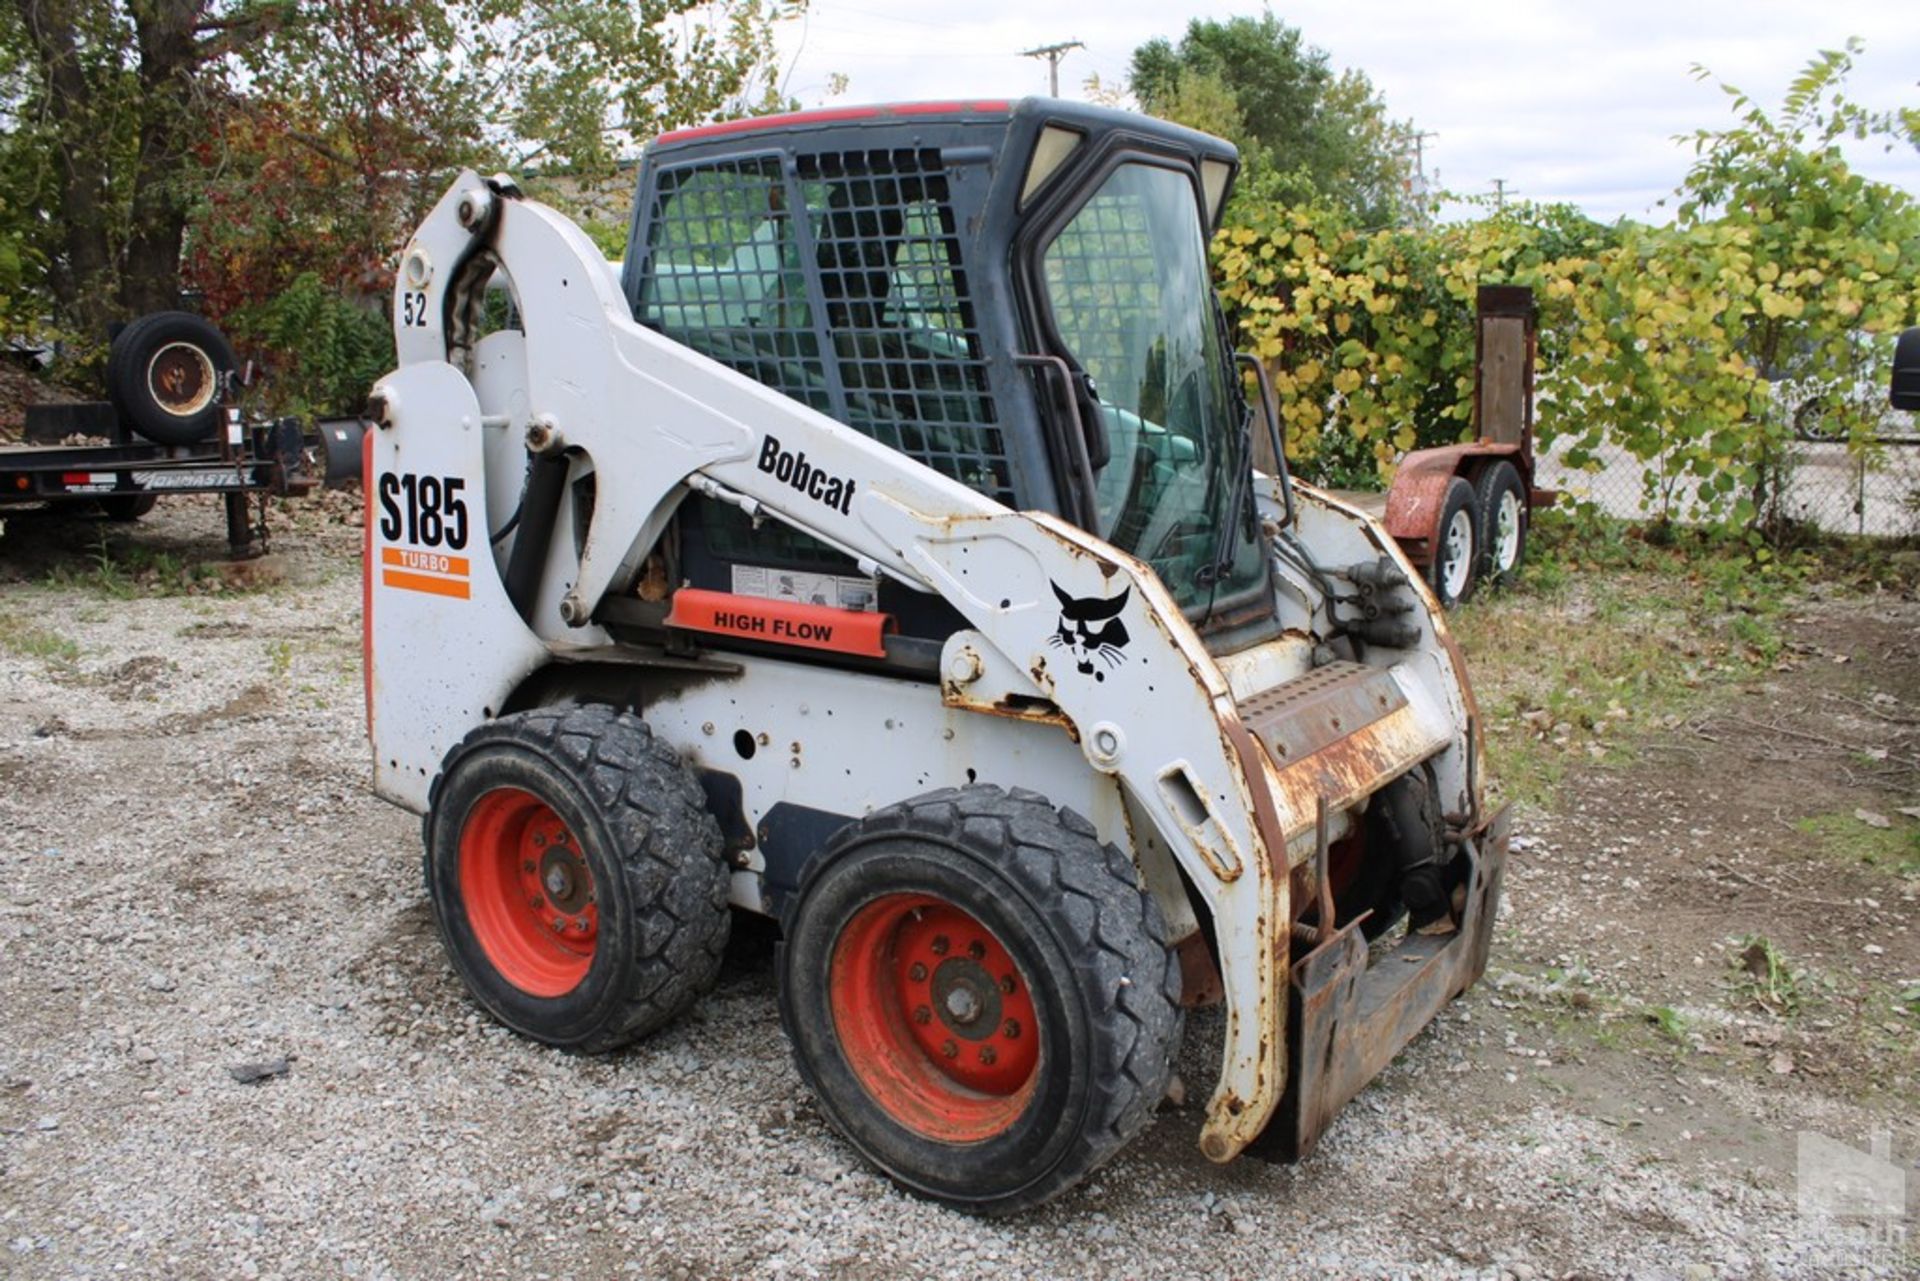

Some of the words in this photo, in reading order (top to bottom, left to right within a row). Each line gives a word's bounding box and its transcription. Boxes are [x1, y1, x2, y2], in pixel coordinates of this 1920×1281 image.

[404, 291, 427, 327] 52
[757, 433, 856, 517] Bobcat
[378, 471, 468, 551] S185
[399, 551, 450, 573] TURBO
[714, 611, 766, 633] HIGH
[772, 619, 833, 642] FLOW
